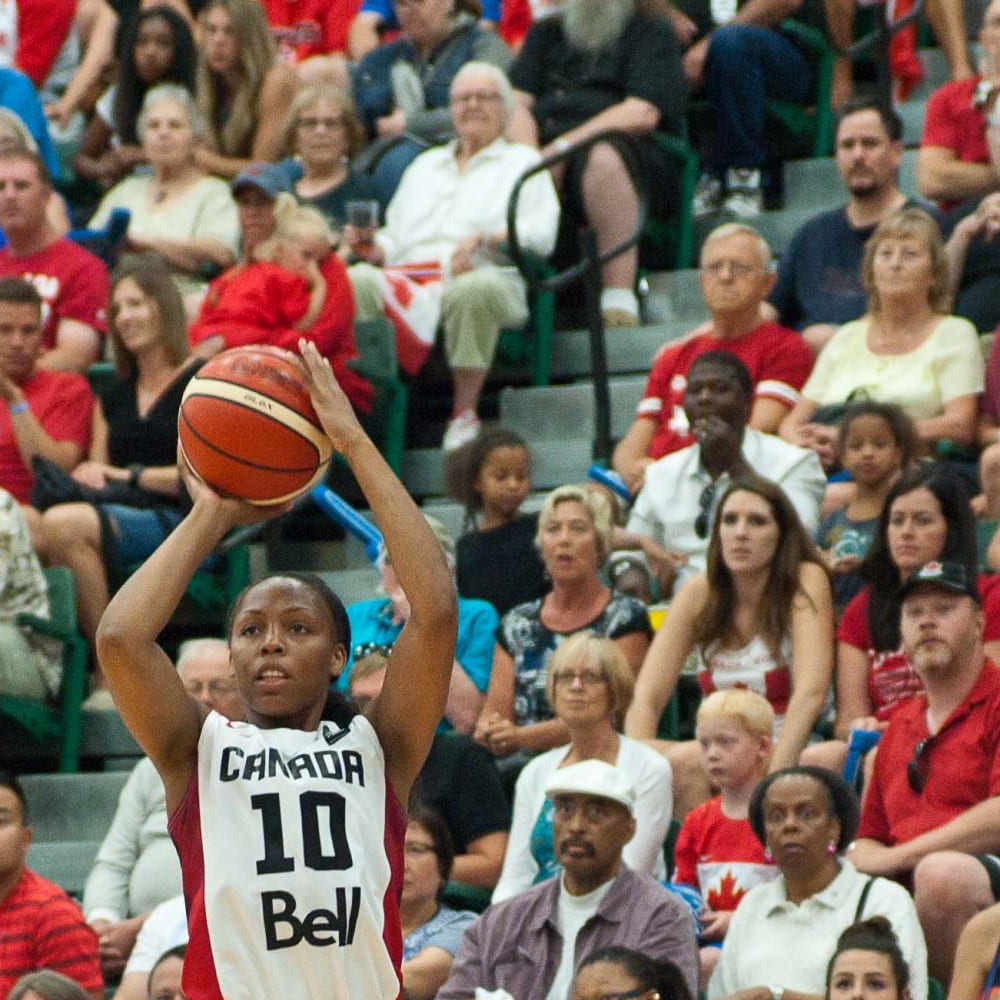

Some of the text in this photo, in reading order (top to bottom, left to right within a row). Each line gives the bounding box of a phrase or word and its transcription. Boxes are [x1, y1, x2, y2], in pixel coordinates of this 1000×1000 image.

[219, 746, 365, 787] CANADA
[250, 790, 353, 875] 10
[261, 886, 361, 951] Bell
